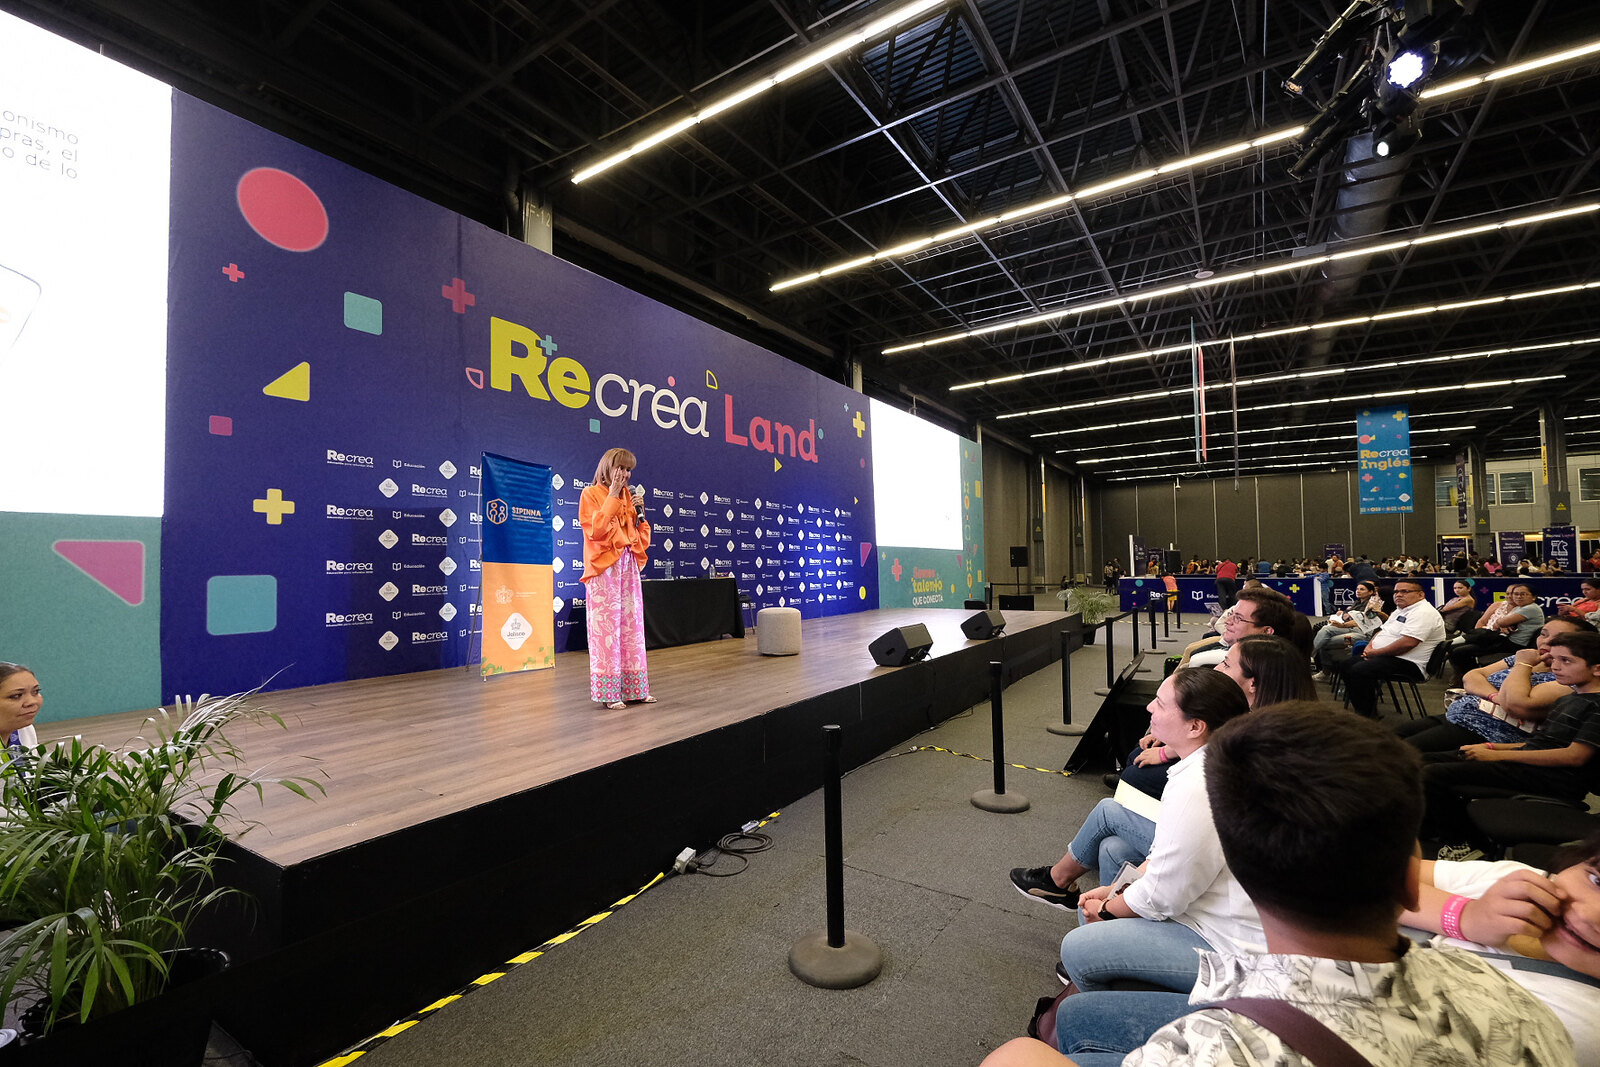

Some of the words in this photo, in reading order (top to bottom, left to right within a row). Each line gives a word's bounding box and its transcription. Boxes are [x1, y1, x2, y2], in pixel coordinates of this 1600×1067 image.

[3, 110, 78, 144] onismo
[62, 149, 78, 162] el
[26, 154, 50, 170] de
[62, 163, 77, 179] lo
[725, 394, 818, 463] Land
[327, 449, 374, 465] Recrea
[1360, 449, 1409, 458] Recrea
[1361, 457, 1410, 471] Inglés
[574, 478, 593, 487] Recr
[412, 483, 448, 496] Recrea
[327, 504, 374, 517] Recrea
[512, 507, 542, 517] SIPINNA
[412, 533, 448, 543] Recrea
[326, 560, 374, 571] Recrea
[412, 584, 448, 593] Recrea
[326, 612, 374, 624] Recrea
[412, 631, 448, 641] Recrea
